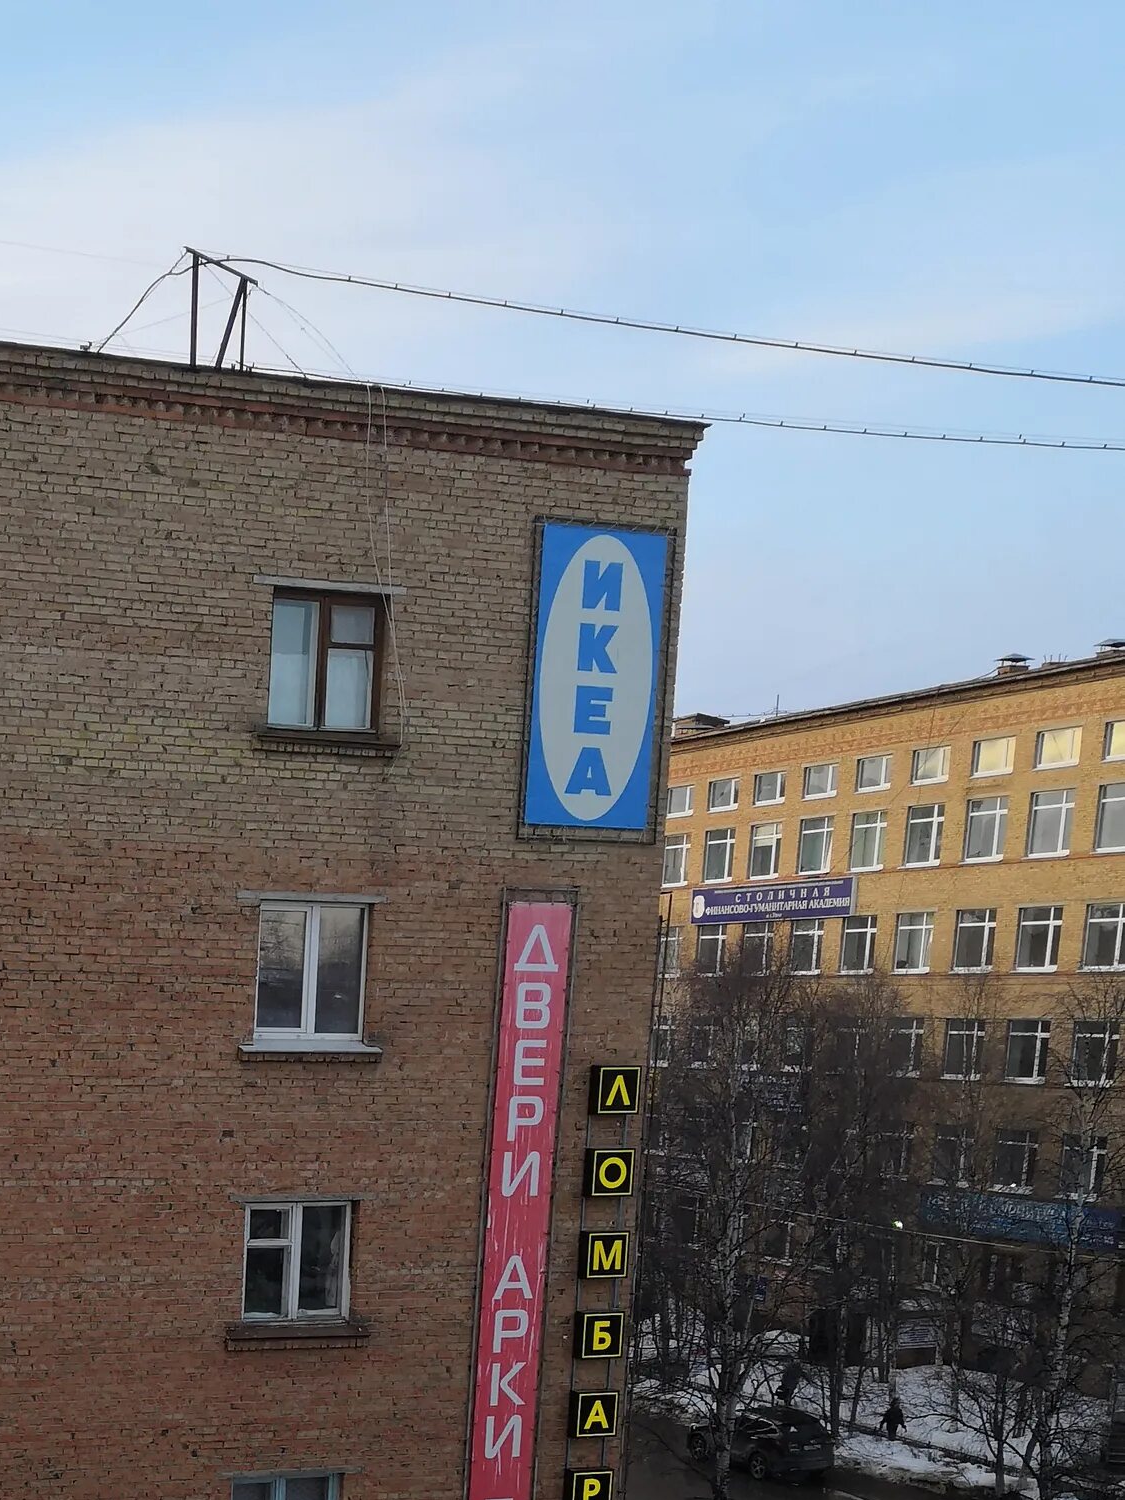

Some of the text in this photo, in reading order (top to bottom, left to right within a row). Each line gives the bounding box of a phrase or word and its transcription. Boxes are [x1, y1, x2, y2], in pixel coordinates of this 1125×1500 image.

[563, 559, 624, 797] ИКЕА
[705, 896, 850, 916] ФИНАНСОВО-ГУМАНИТАРНАЯ АКАДЕМИЯ
[735, 887, 831, 903] СТОЛИЧНАЯ
[484, 923, 559, 1459] ДВЕРИ АРКИ
